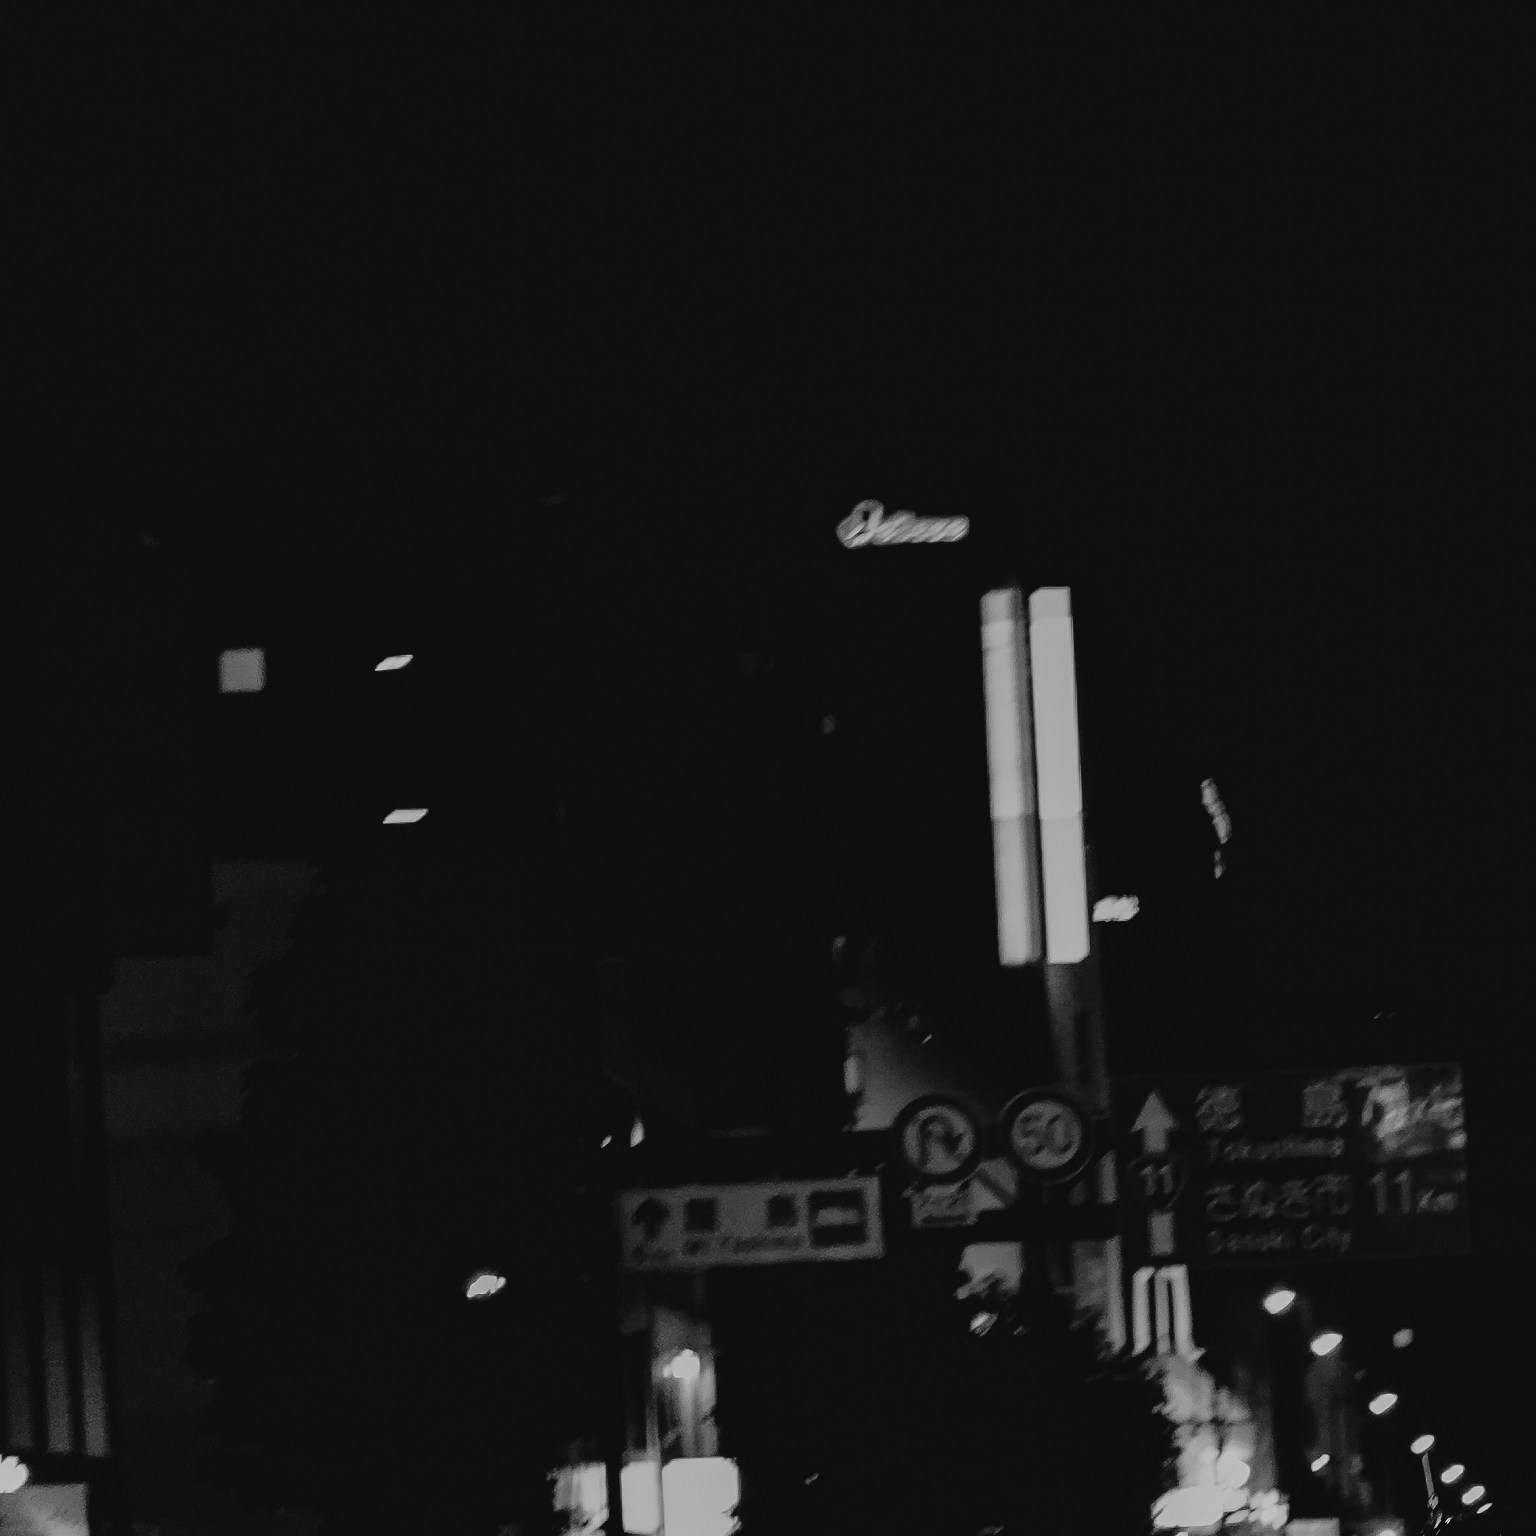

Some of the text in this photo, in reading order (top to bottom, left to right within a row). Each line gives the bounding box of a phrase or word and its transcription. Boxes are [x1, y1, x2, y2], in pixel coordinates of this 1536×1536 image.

[1020, 1112, 1073, 1156] 50
[1138, 1163, 1174, 1198] 11
[1368, 1169, 1412, 1215] 11
